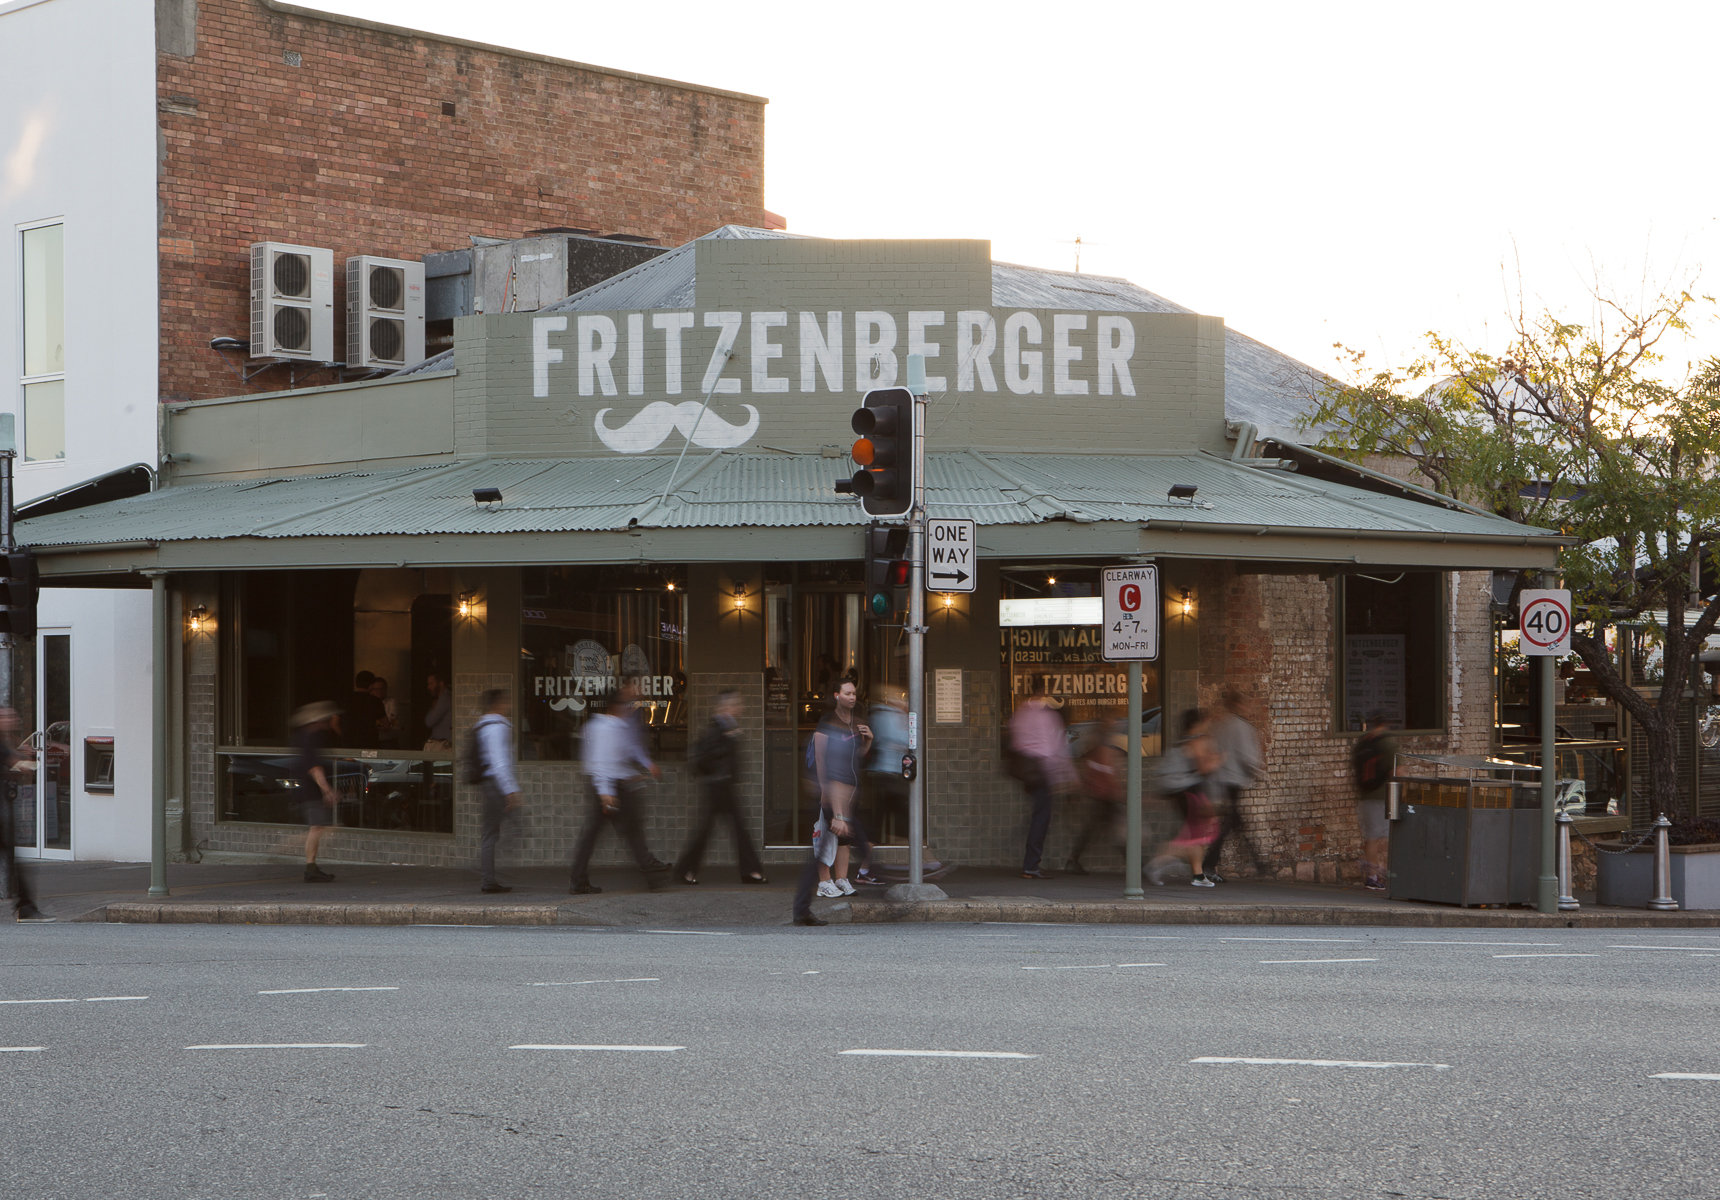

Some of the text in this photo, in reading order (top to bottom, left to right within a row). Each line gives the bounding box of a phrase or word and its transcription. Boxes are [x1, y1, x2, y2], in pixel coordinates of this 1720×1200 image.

[532, 310, 1137, 398] FRITZENBERGER
[935, 525, 967, 541] ONE
[932, 547, 969, 564] WAY
[1106, 570, 1153, 581] CLEARWAY
[1124, 587, 1136, 609] C
[1526, 610, 1562, 634] 40
[1112, 641, 1148, 650] MON-FRI
[1347, 639, 1399, 648] FRITZENBERGER
[1013, 673, 1148, 695] FRTZENBERGR
[657, 700, 668, 708] PUB
[1068, 698, 1086, 706] FRITES
[1087, 698, 1097, 706] AND
[1097, 698, 1117, 706] BURGER
